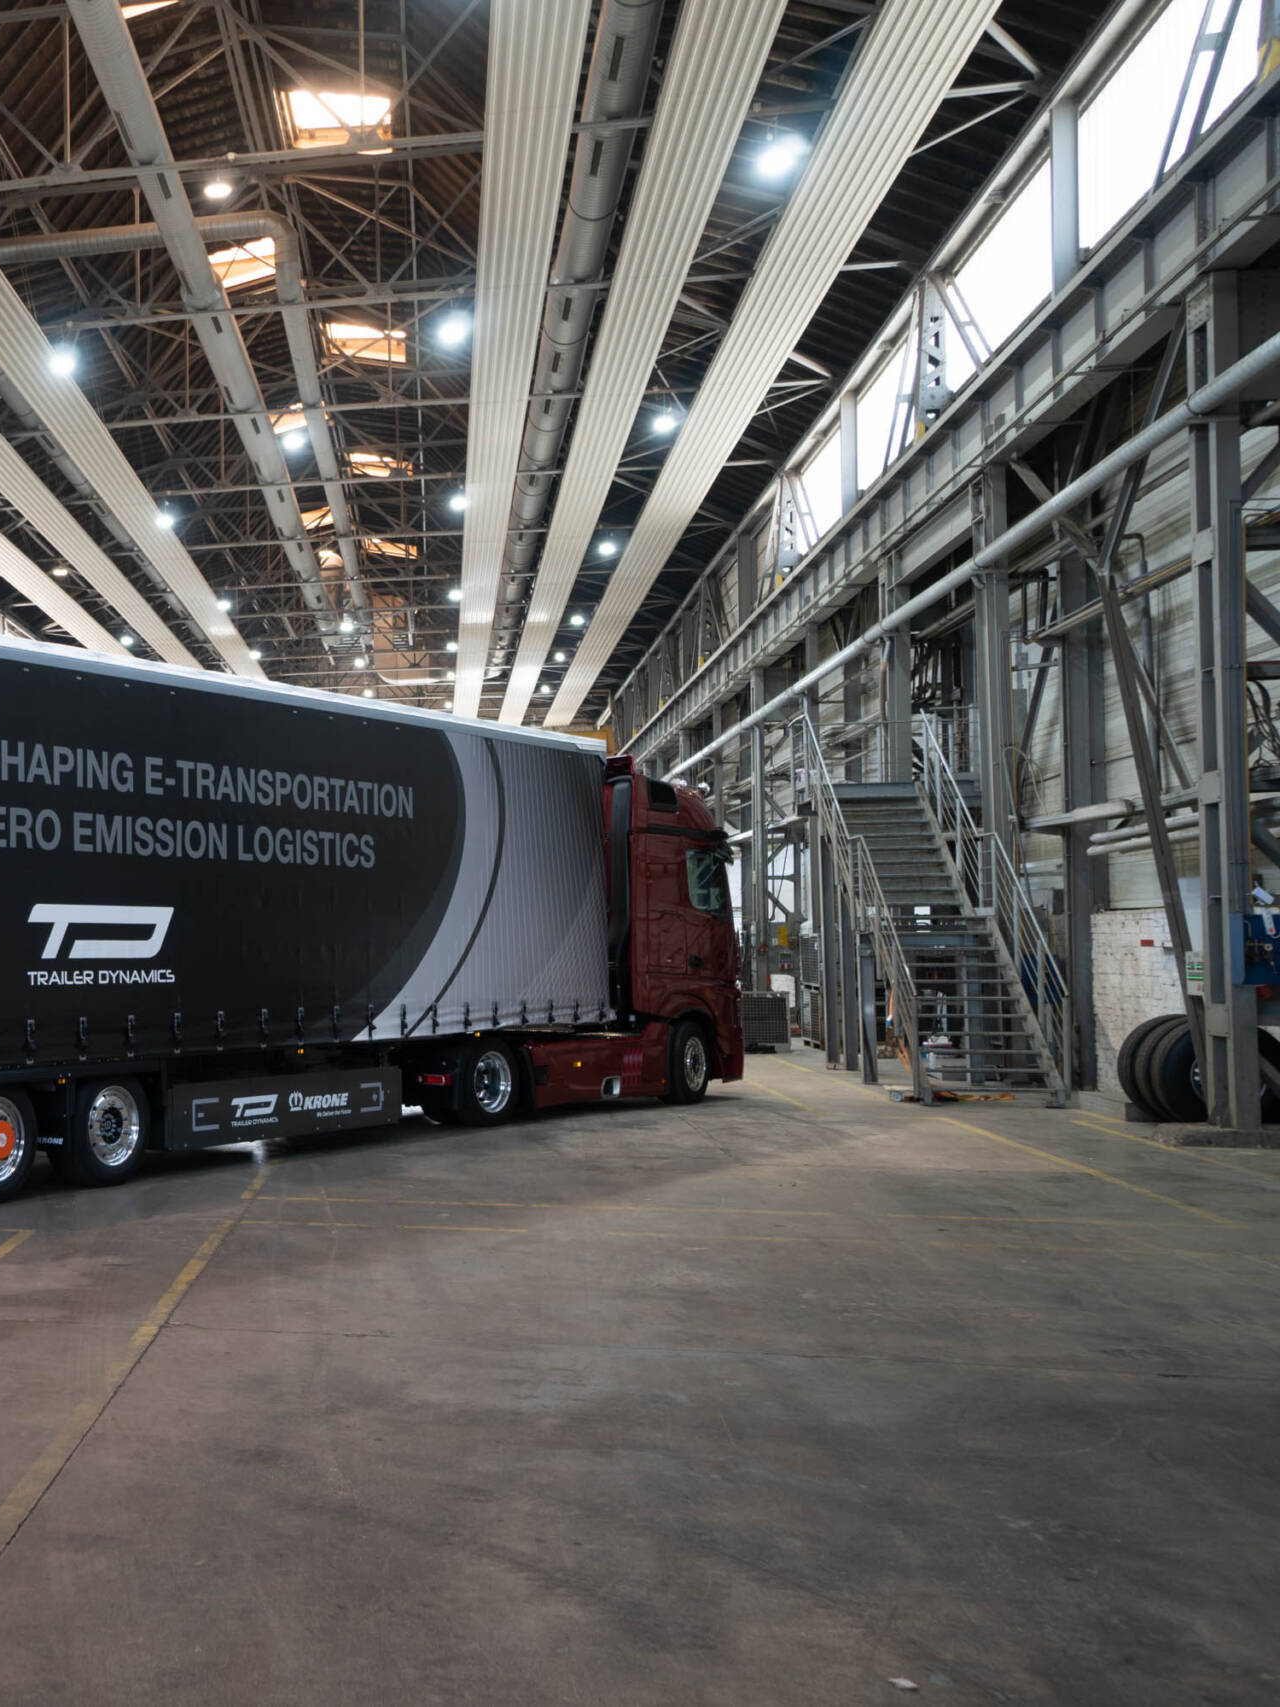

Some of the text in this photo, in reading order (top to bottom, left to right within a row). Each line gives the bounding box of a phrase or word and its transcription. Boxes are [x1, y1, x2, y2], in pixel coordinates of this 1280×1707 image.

[144, 756, 414, 819] E-TRANSPORTATION
[73, 811, 228, 861] EMISSION
[237, 825, 376, 869] LOGISTICS
[27, 969, 176, 986] TRAILER DYNAMICS
[303, 1092, 349, 1110] KRONE
